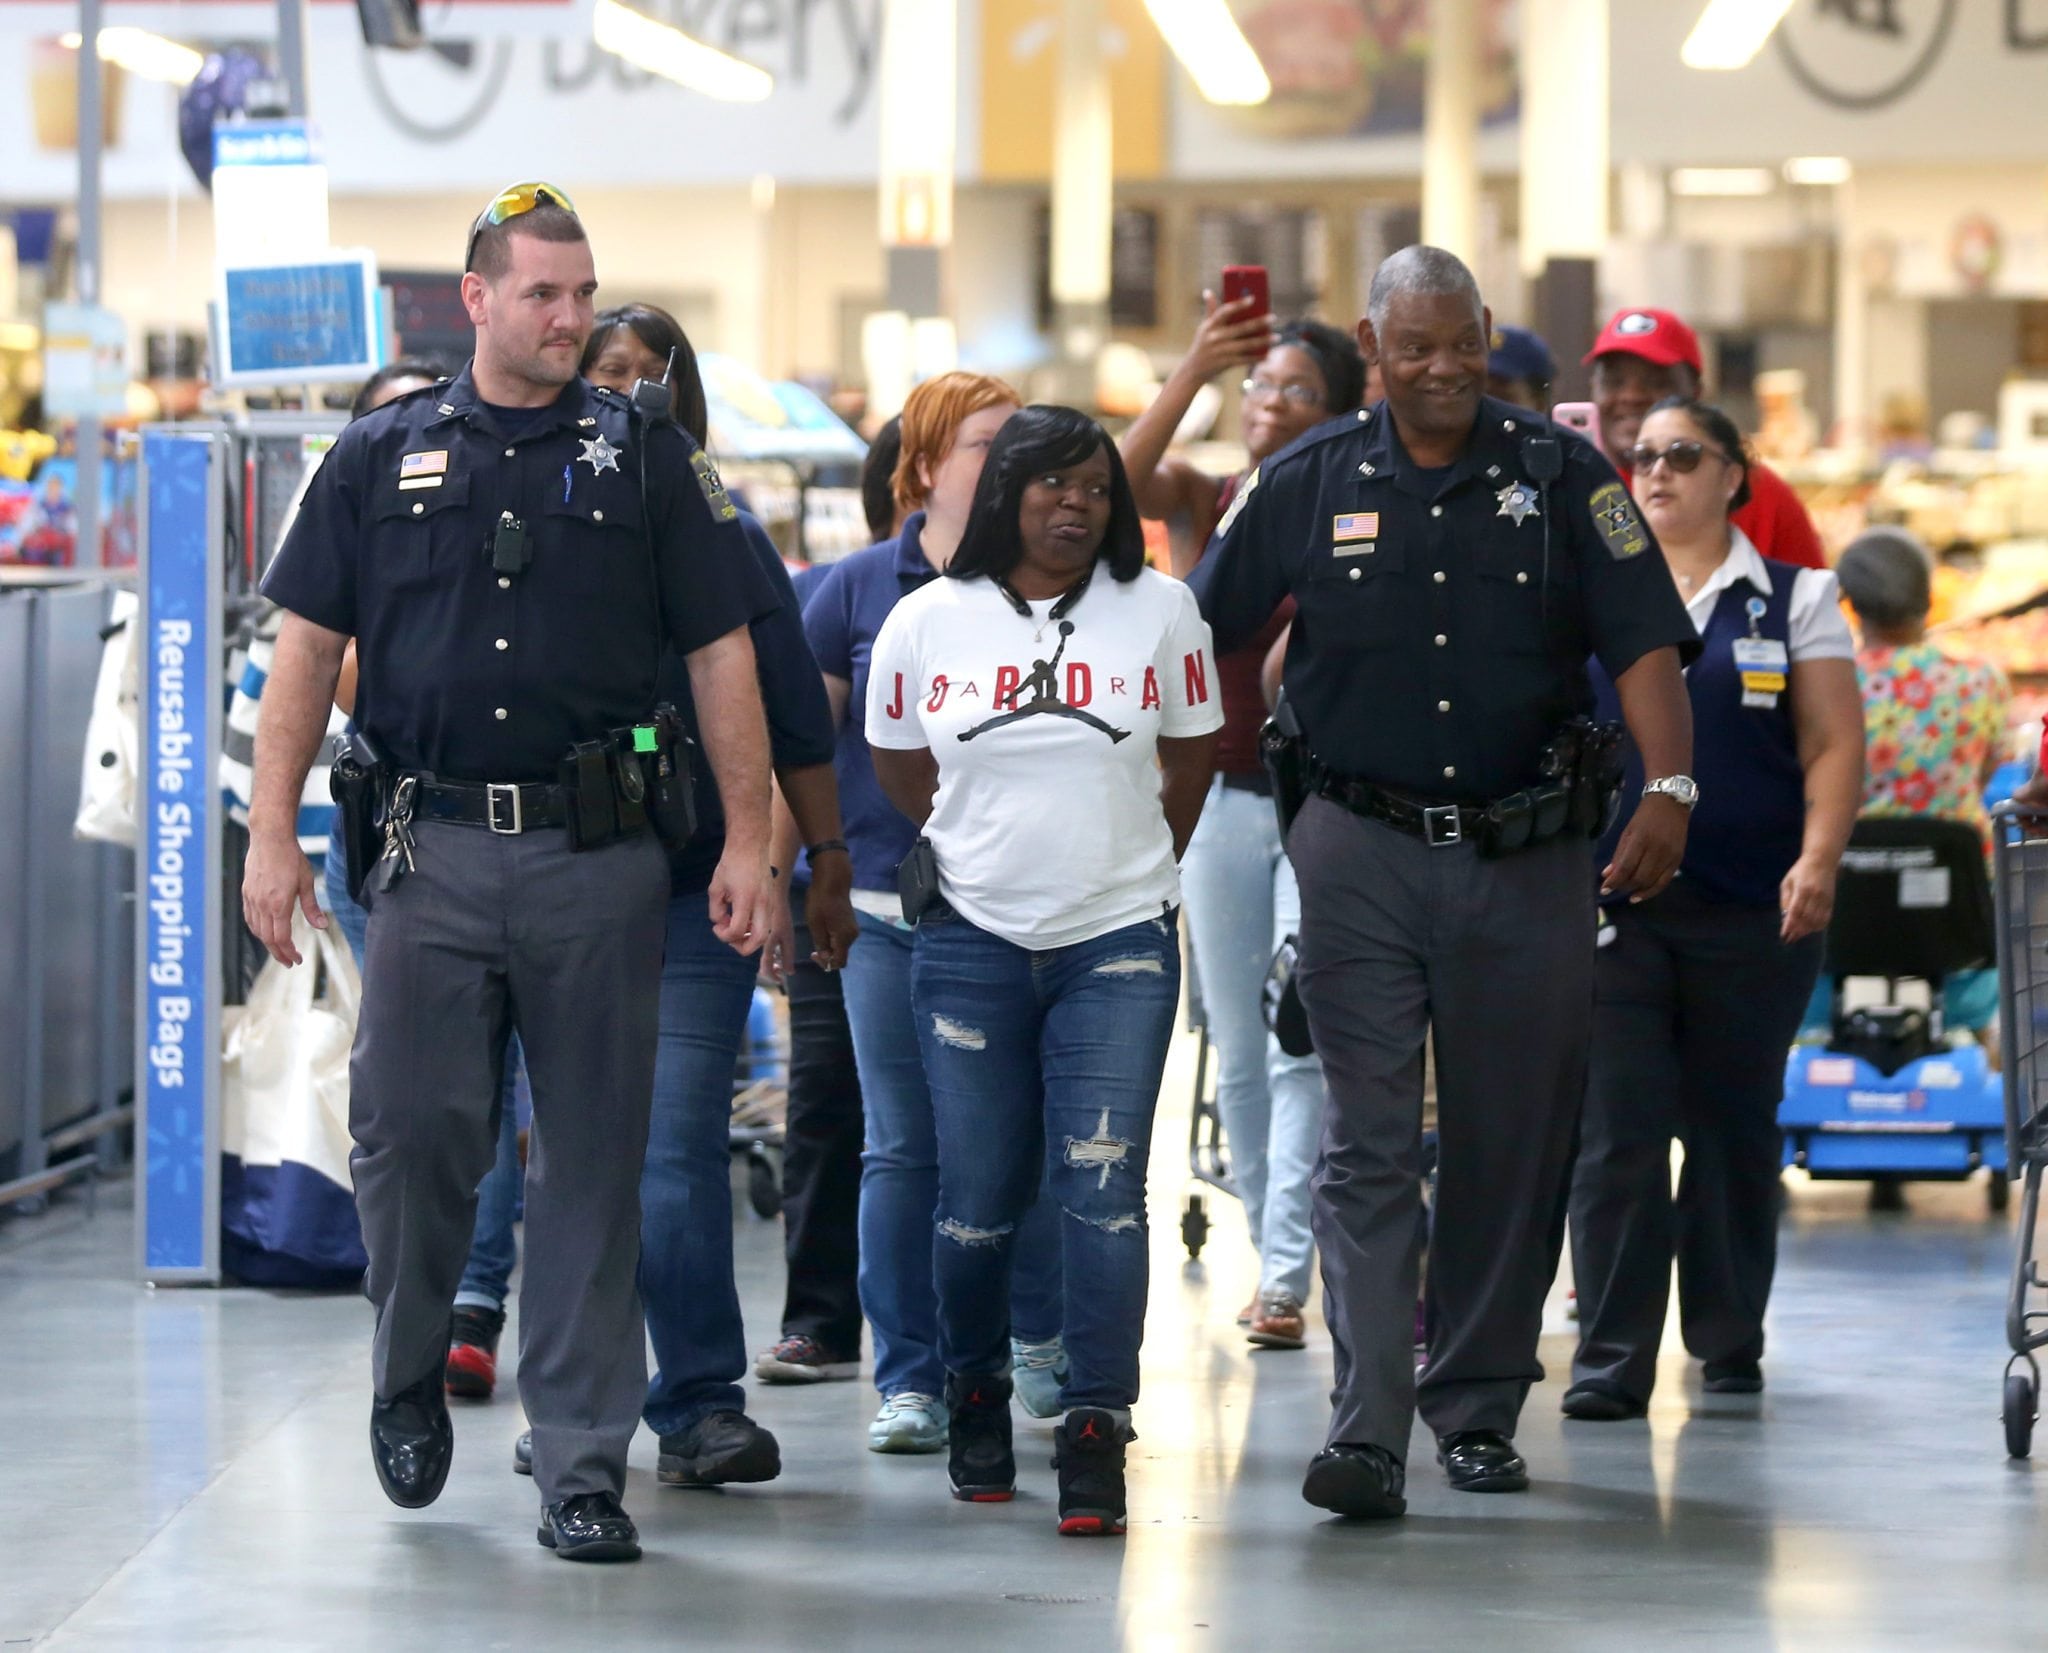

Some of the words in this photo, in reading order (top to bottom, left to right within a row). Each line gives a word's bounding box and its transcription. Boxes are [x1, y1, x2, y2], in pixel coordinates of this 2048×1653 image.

[158, 619, 192, 793] Reusable
[150, 802, 192, 987] Shopping
[150, 996, 191, 1088] Bags
